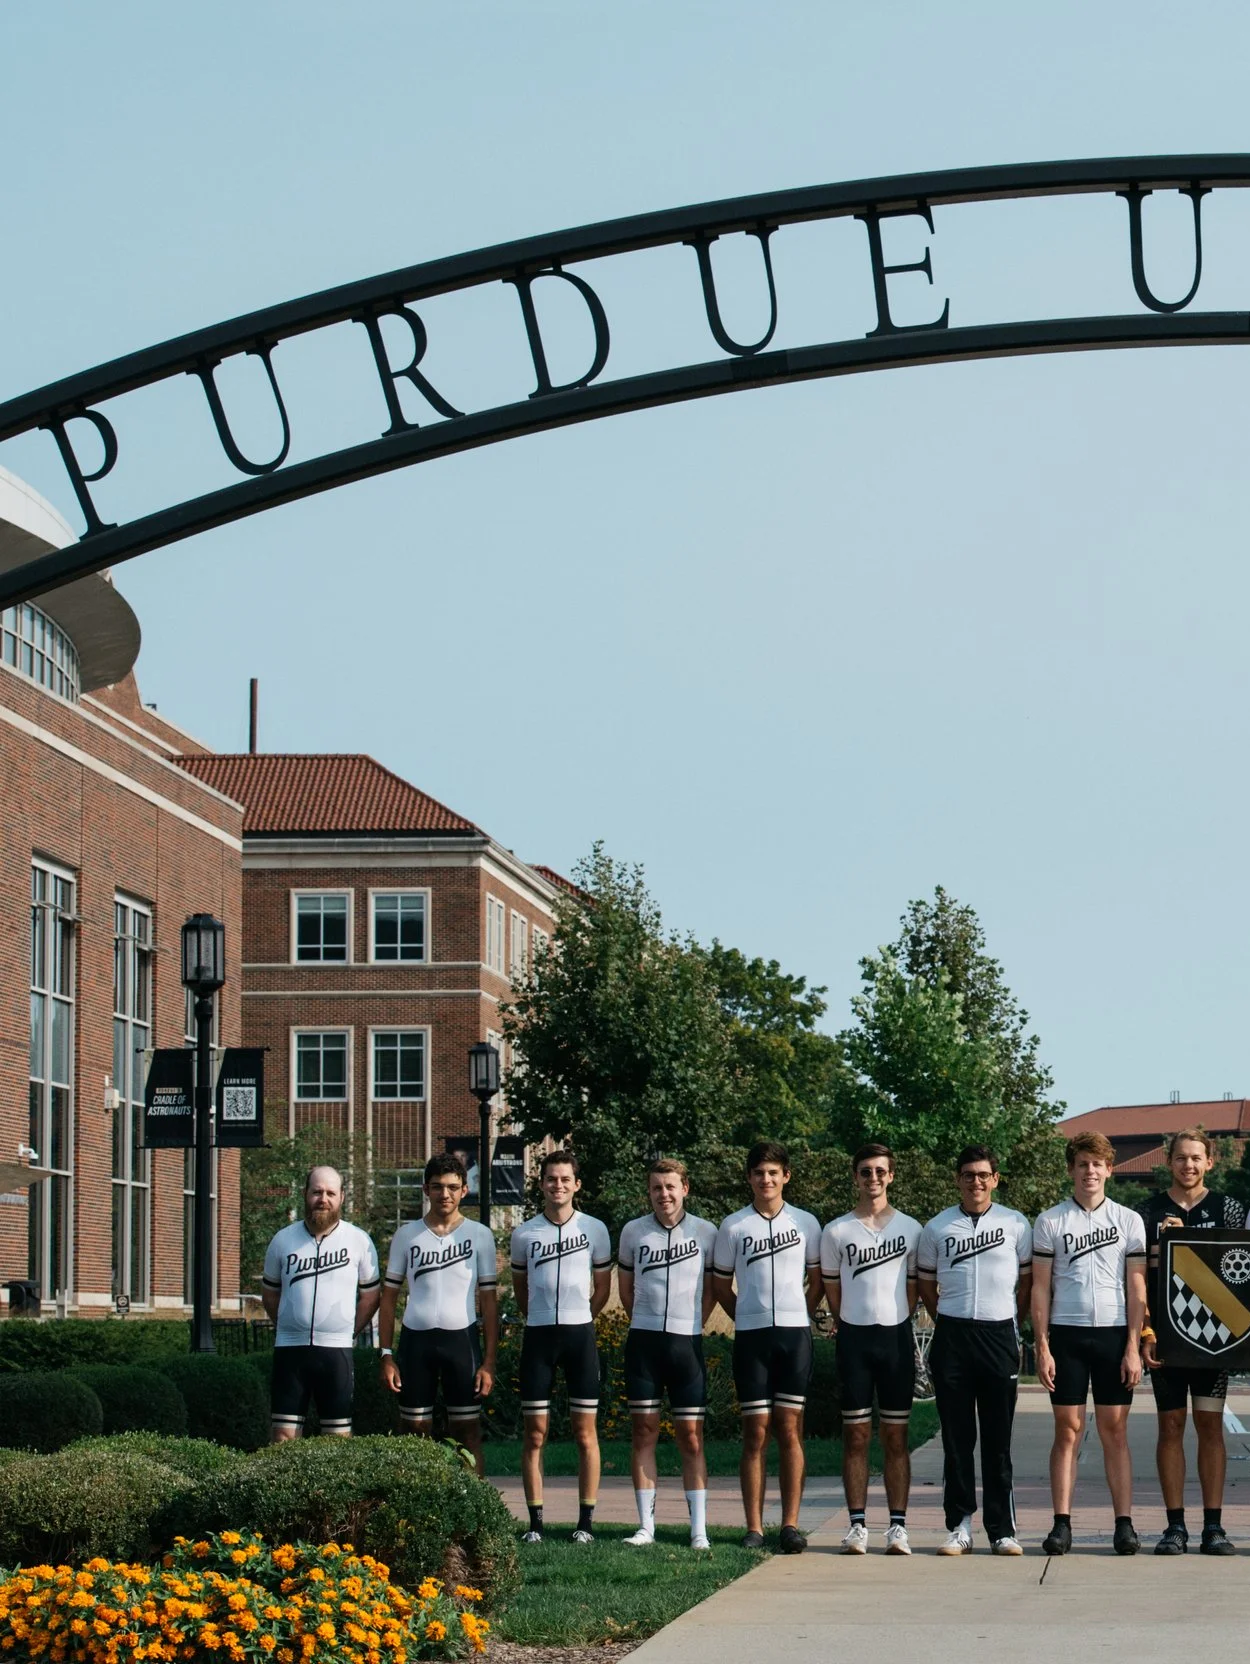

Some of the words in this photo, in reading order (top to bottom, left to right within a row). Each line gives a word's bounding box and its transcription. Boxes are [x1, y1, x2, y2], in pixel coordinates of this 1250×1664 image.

[38, 203, 950, 540] PURDUE
[147, 1106, 191, 1116] ASTRONAUTS
[152, 1095, 177, 1105] CRADLE
[177, 1095, 187, 1104] OF
[410, 1239, 473, 1269] Purdue
[531, 1233, 589, 1259] Purdue
[639, 1239, 699, 1265] Purdue
[743, 1228, 800, 1256] Purdue
[846, 1235, 907, 1267] Purdue
[945, 1228, 1005, 1258] Purdue
[1063, 1226, 1119, 1255] Purdue
[286, 1248, 350, 1276] Purdue
